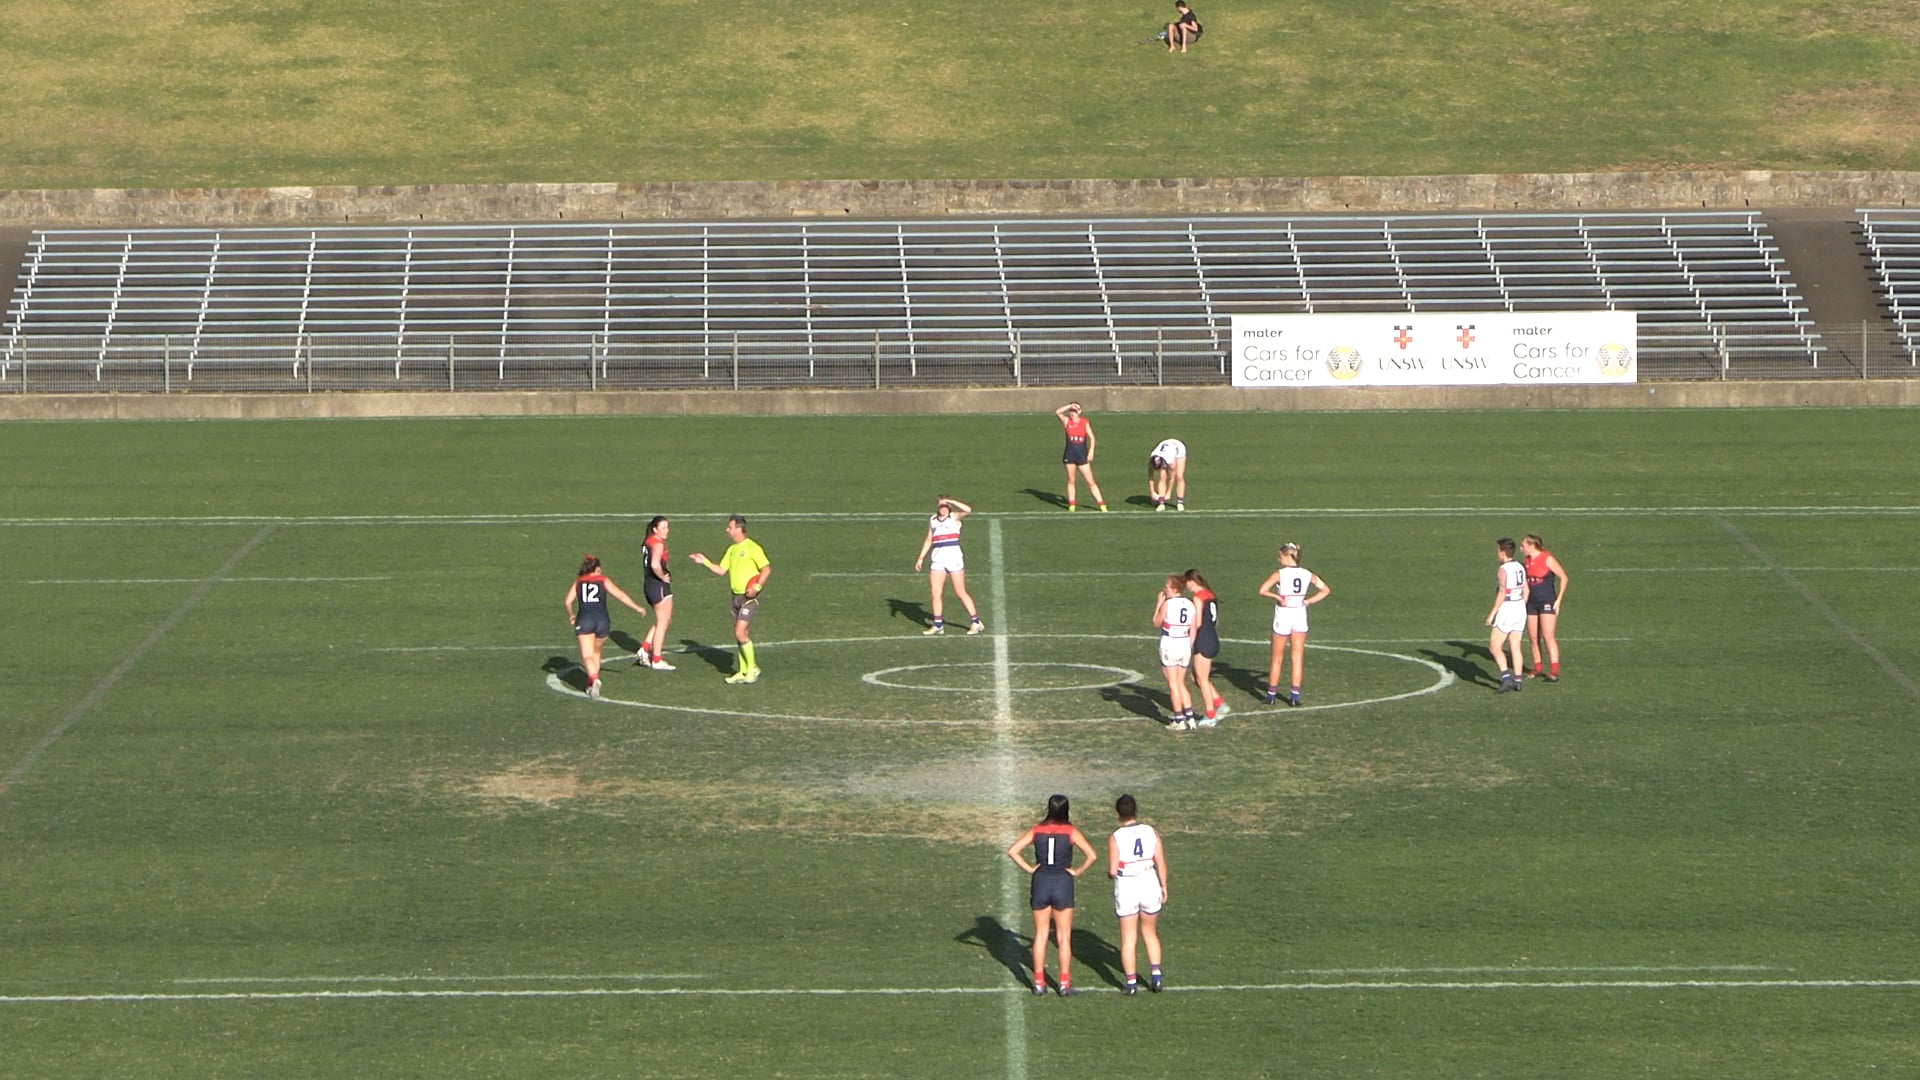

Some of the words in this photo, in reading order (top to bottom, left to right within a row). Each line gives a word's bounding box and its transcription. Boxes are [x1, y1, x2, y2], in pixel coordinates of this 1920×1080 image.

[1243, 328, 1283, 338] mater
[1513, 326, 1553, 336] mater
[1243, 345, 1288, 362] Cars
[1296, 344, 1321, 361] for
[1513, 342, 1557, 359] Cars
[1565, 341, 1590, 358] for
[1379, 357, 1427, 371] UNSW
[1441, 356, 1490, 370] UNSW
[1513, 362, 1583, 379] Cancer
[1243, 364, 1313, 381] Cancer
[581, 582, 600, 603] 12
[1292, 577, 1302, 594] 9
[1179, 607, 1188, 624] 6
[1047, 837, 1056, 865] 1
[1133, 838, 1144, 858] 4
